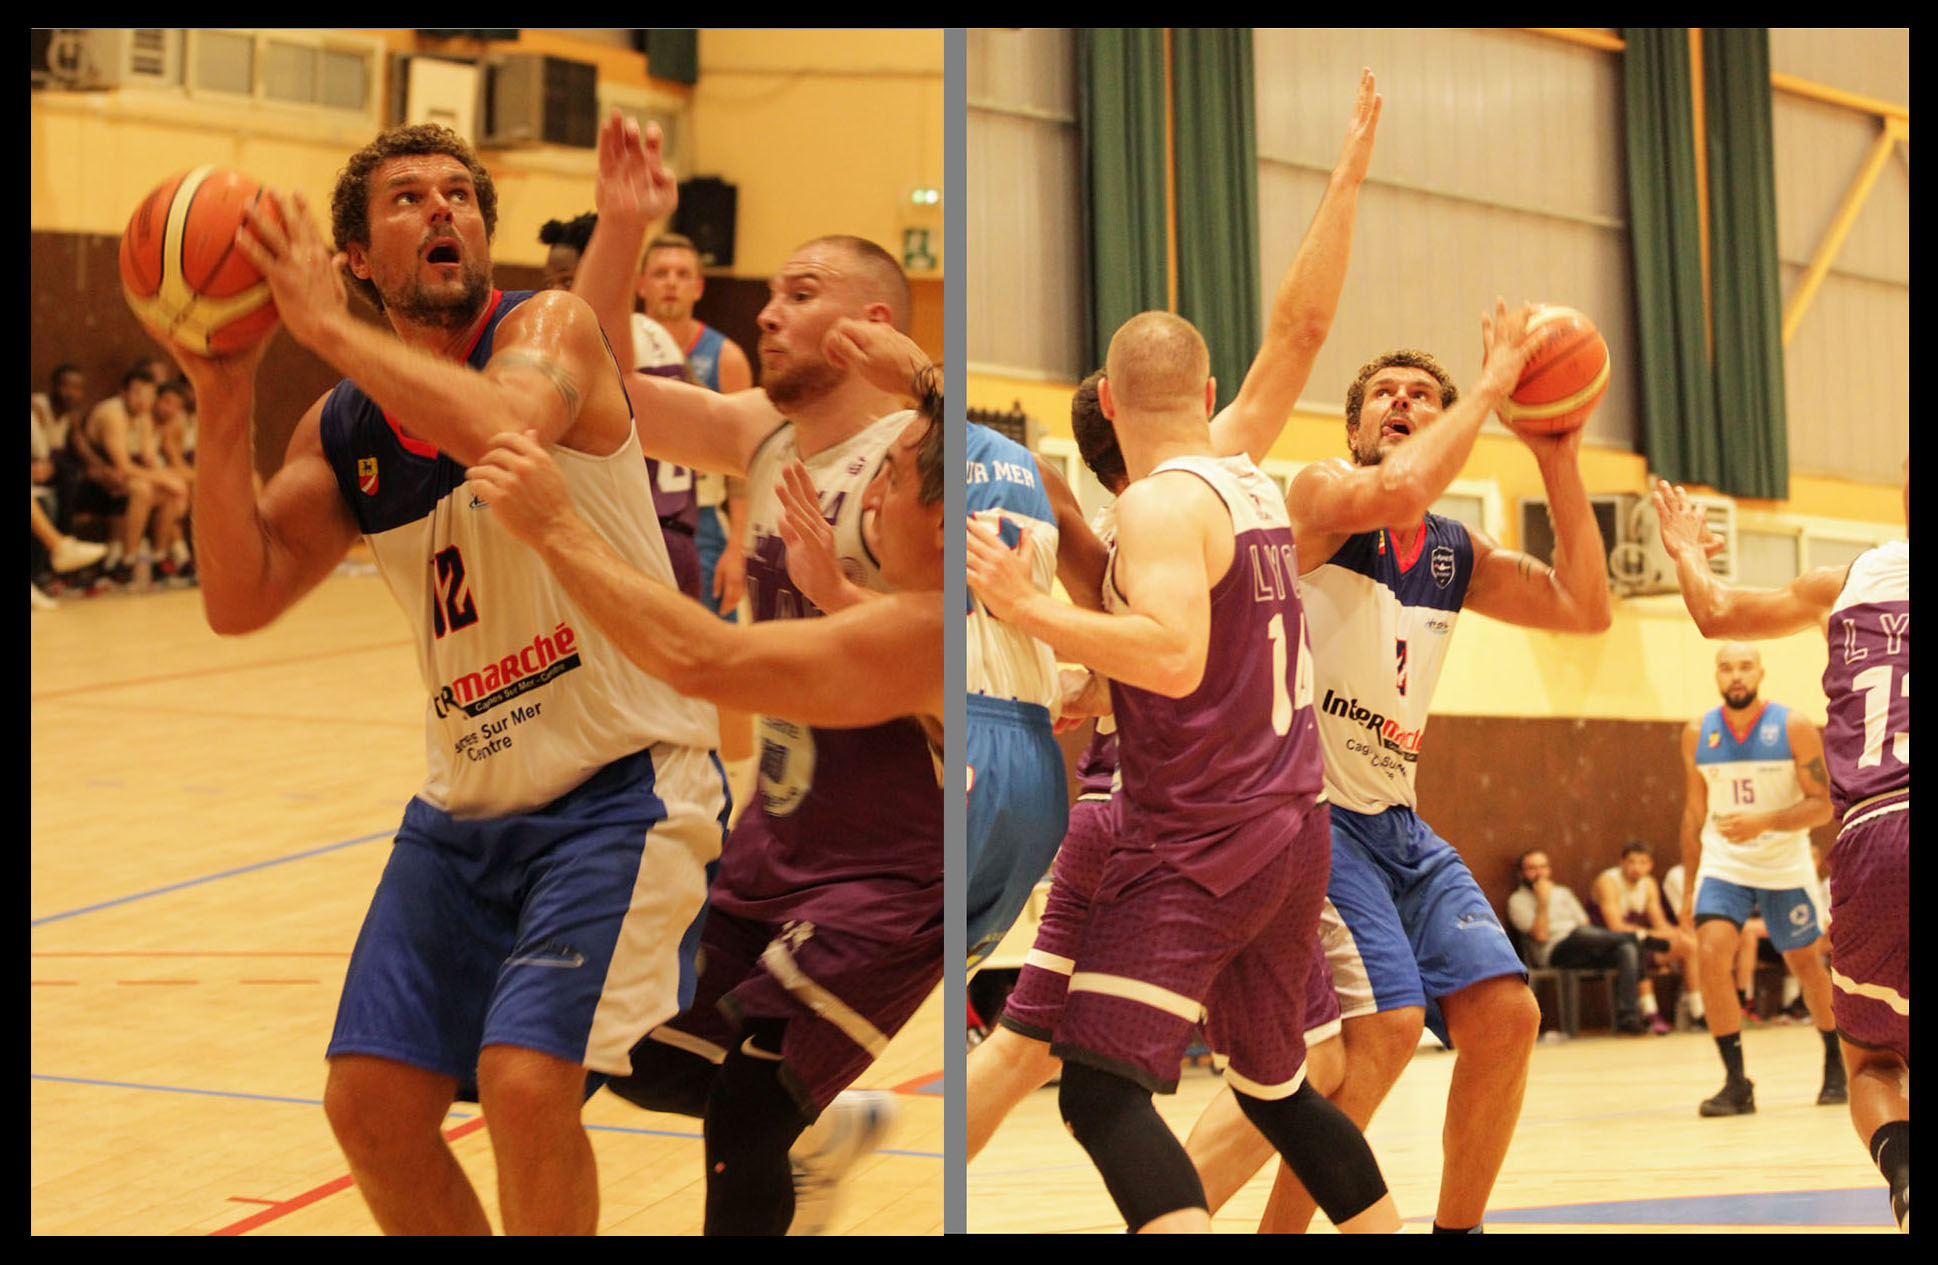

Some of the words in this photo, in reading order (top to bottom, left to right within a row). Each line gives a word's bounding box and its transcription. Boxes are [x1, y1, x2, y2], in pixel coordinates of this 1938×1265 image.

[992, 460, 1035, 488] MER
[481, 717, 508, 740] Sur
[510, 703, 542, 726] Mer
[1733, 779, 1755, 805] 15
